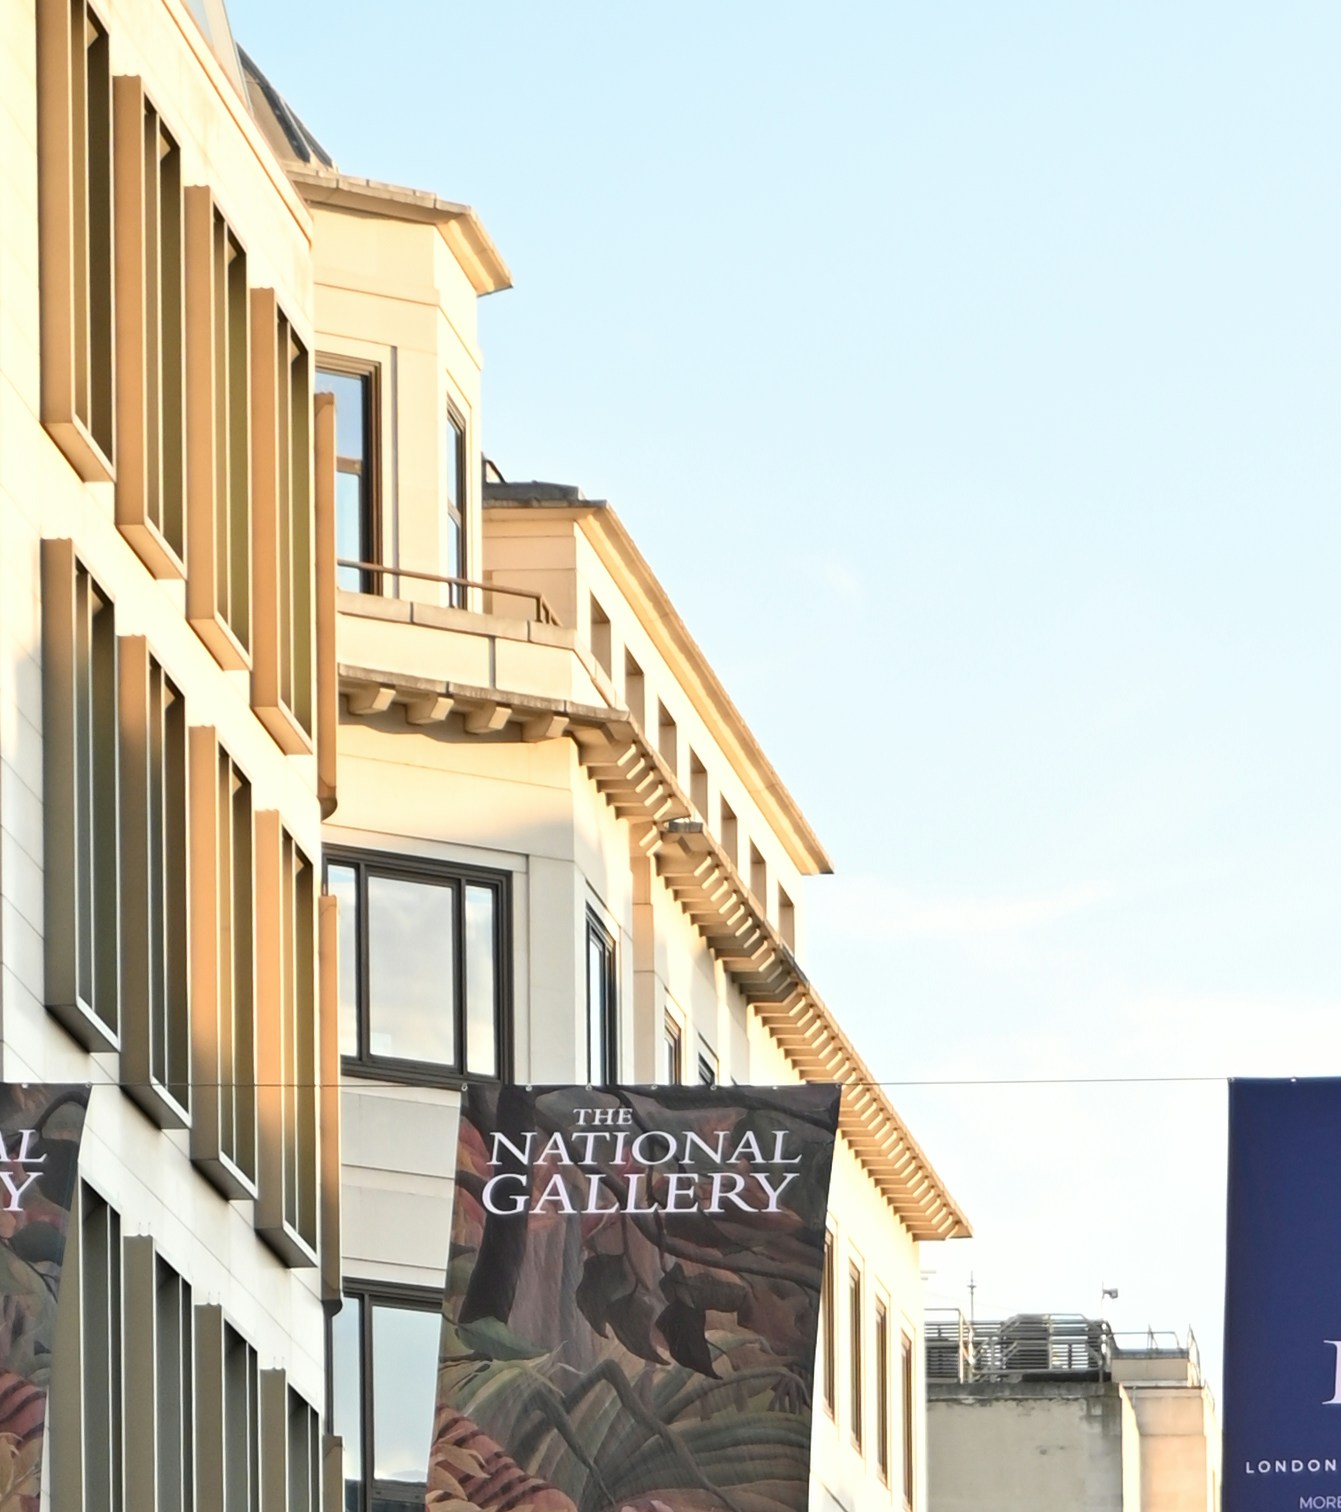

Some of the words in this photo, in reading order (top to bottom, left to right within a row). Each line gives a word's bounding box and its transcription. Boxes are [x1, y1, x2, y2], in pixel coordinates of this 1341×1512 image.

[574, 1107, 632, 1126] THE
[488, 1130, 802, 1167] NATIONAL
[482, 1172, 800, 1215] GALLERY
[1245, 1459, 1338, 1474] LONDON
